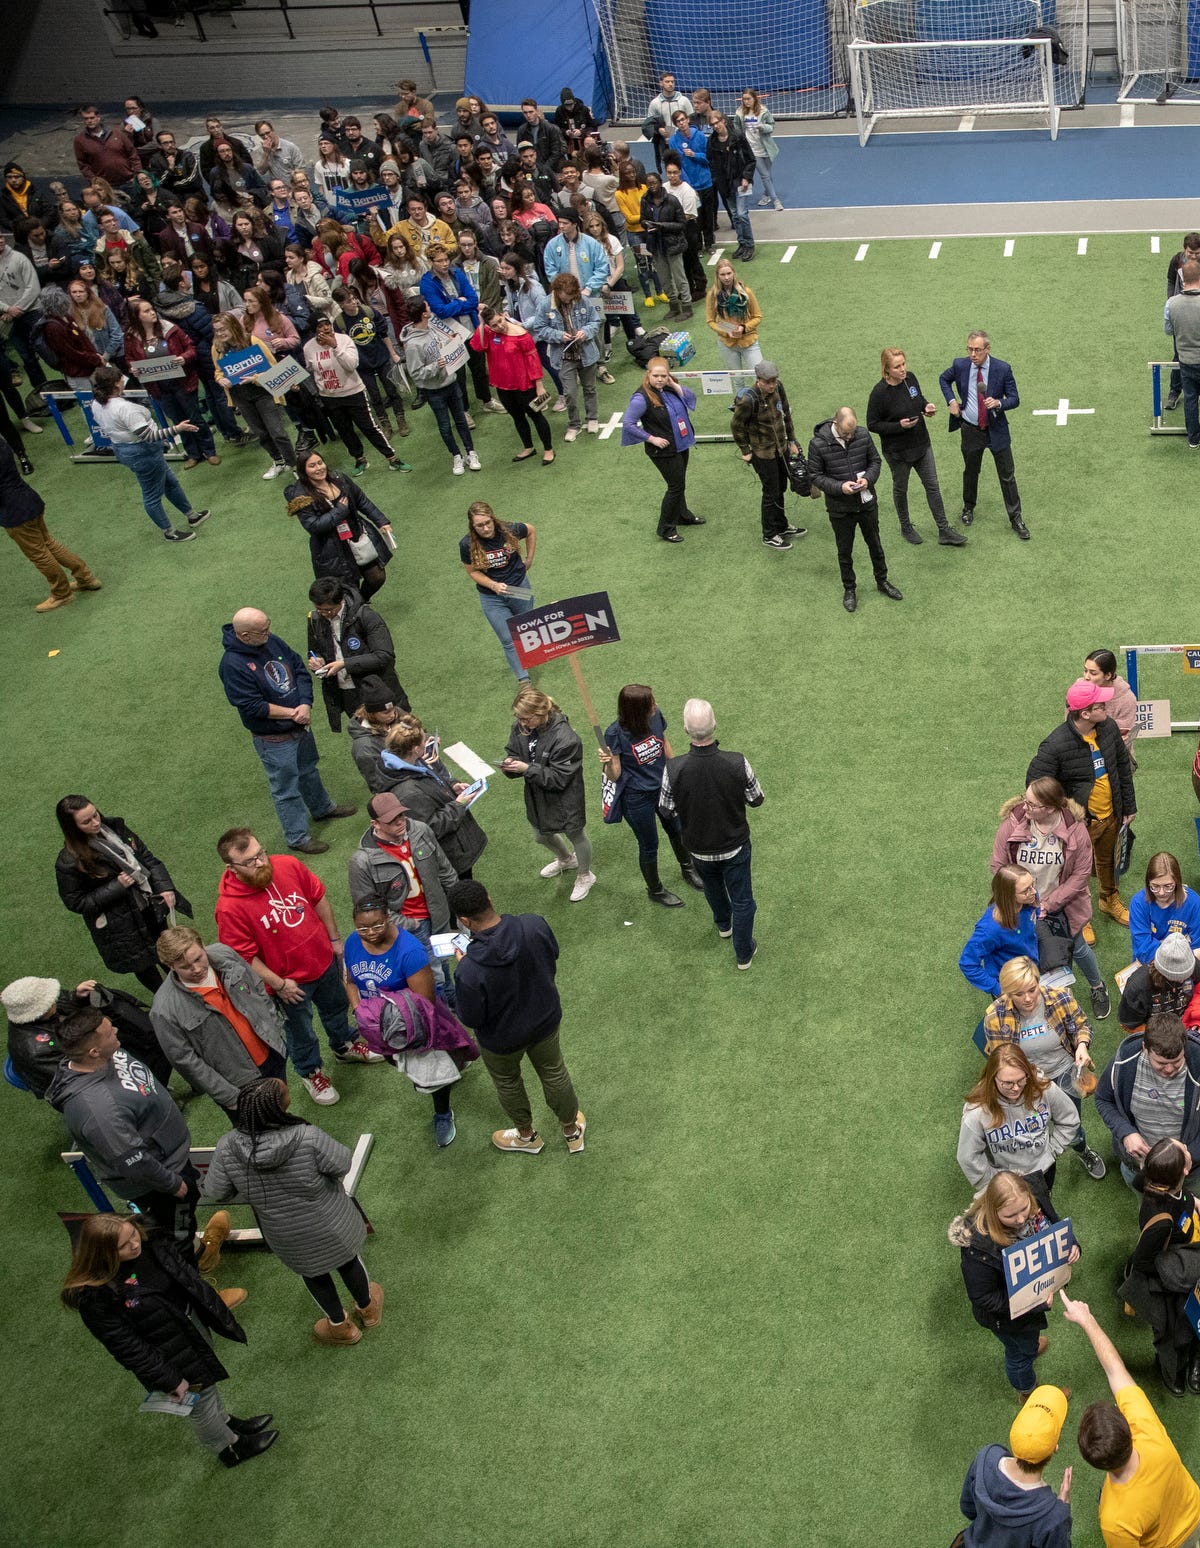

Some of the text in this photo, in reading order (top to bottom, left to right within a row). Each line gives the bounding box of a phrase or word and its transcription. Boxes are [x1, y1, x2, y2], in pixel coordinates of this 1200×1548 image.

[353, 192, 388, 207] Bernie
[224, 353, 264, 377] Bernie
[319, 350, 331, 361] AM
[138, 361, 179, 375] Bernie
[265, 364, 300, 390] Bernie
[516, 611, 565, 633] IOWA FOR
[519, 609, 610, 653] BIDEN
[635, 738, 657, 753] BIDEN
[1093, 757, 1105, 769] ETE
[1019, 849, 1063, 865] BRECK
[351, 961, 393, 981] DRAKE
[1020, 1026, 1046, 1040] PETE
[113, 1050, 140, 1093] DRAKE
[1008, 1226, 1070, 1287] PETE
[1033, 1275, 1055, 1296] Iowa
